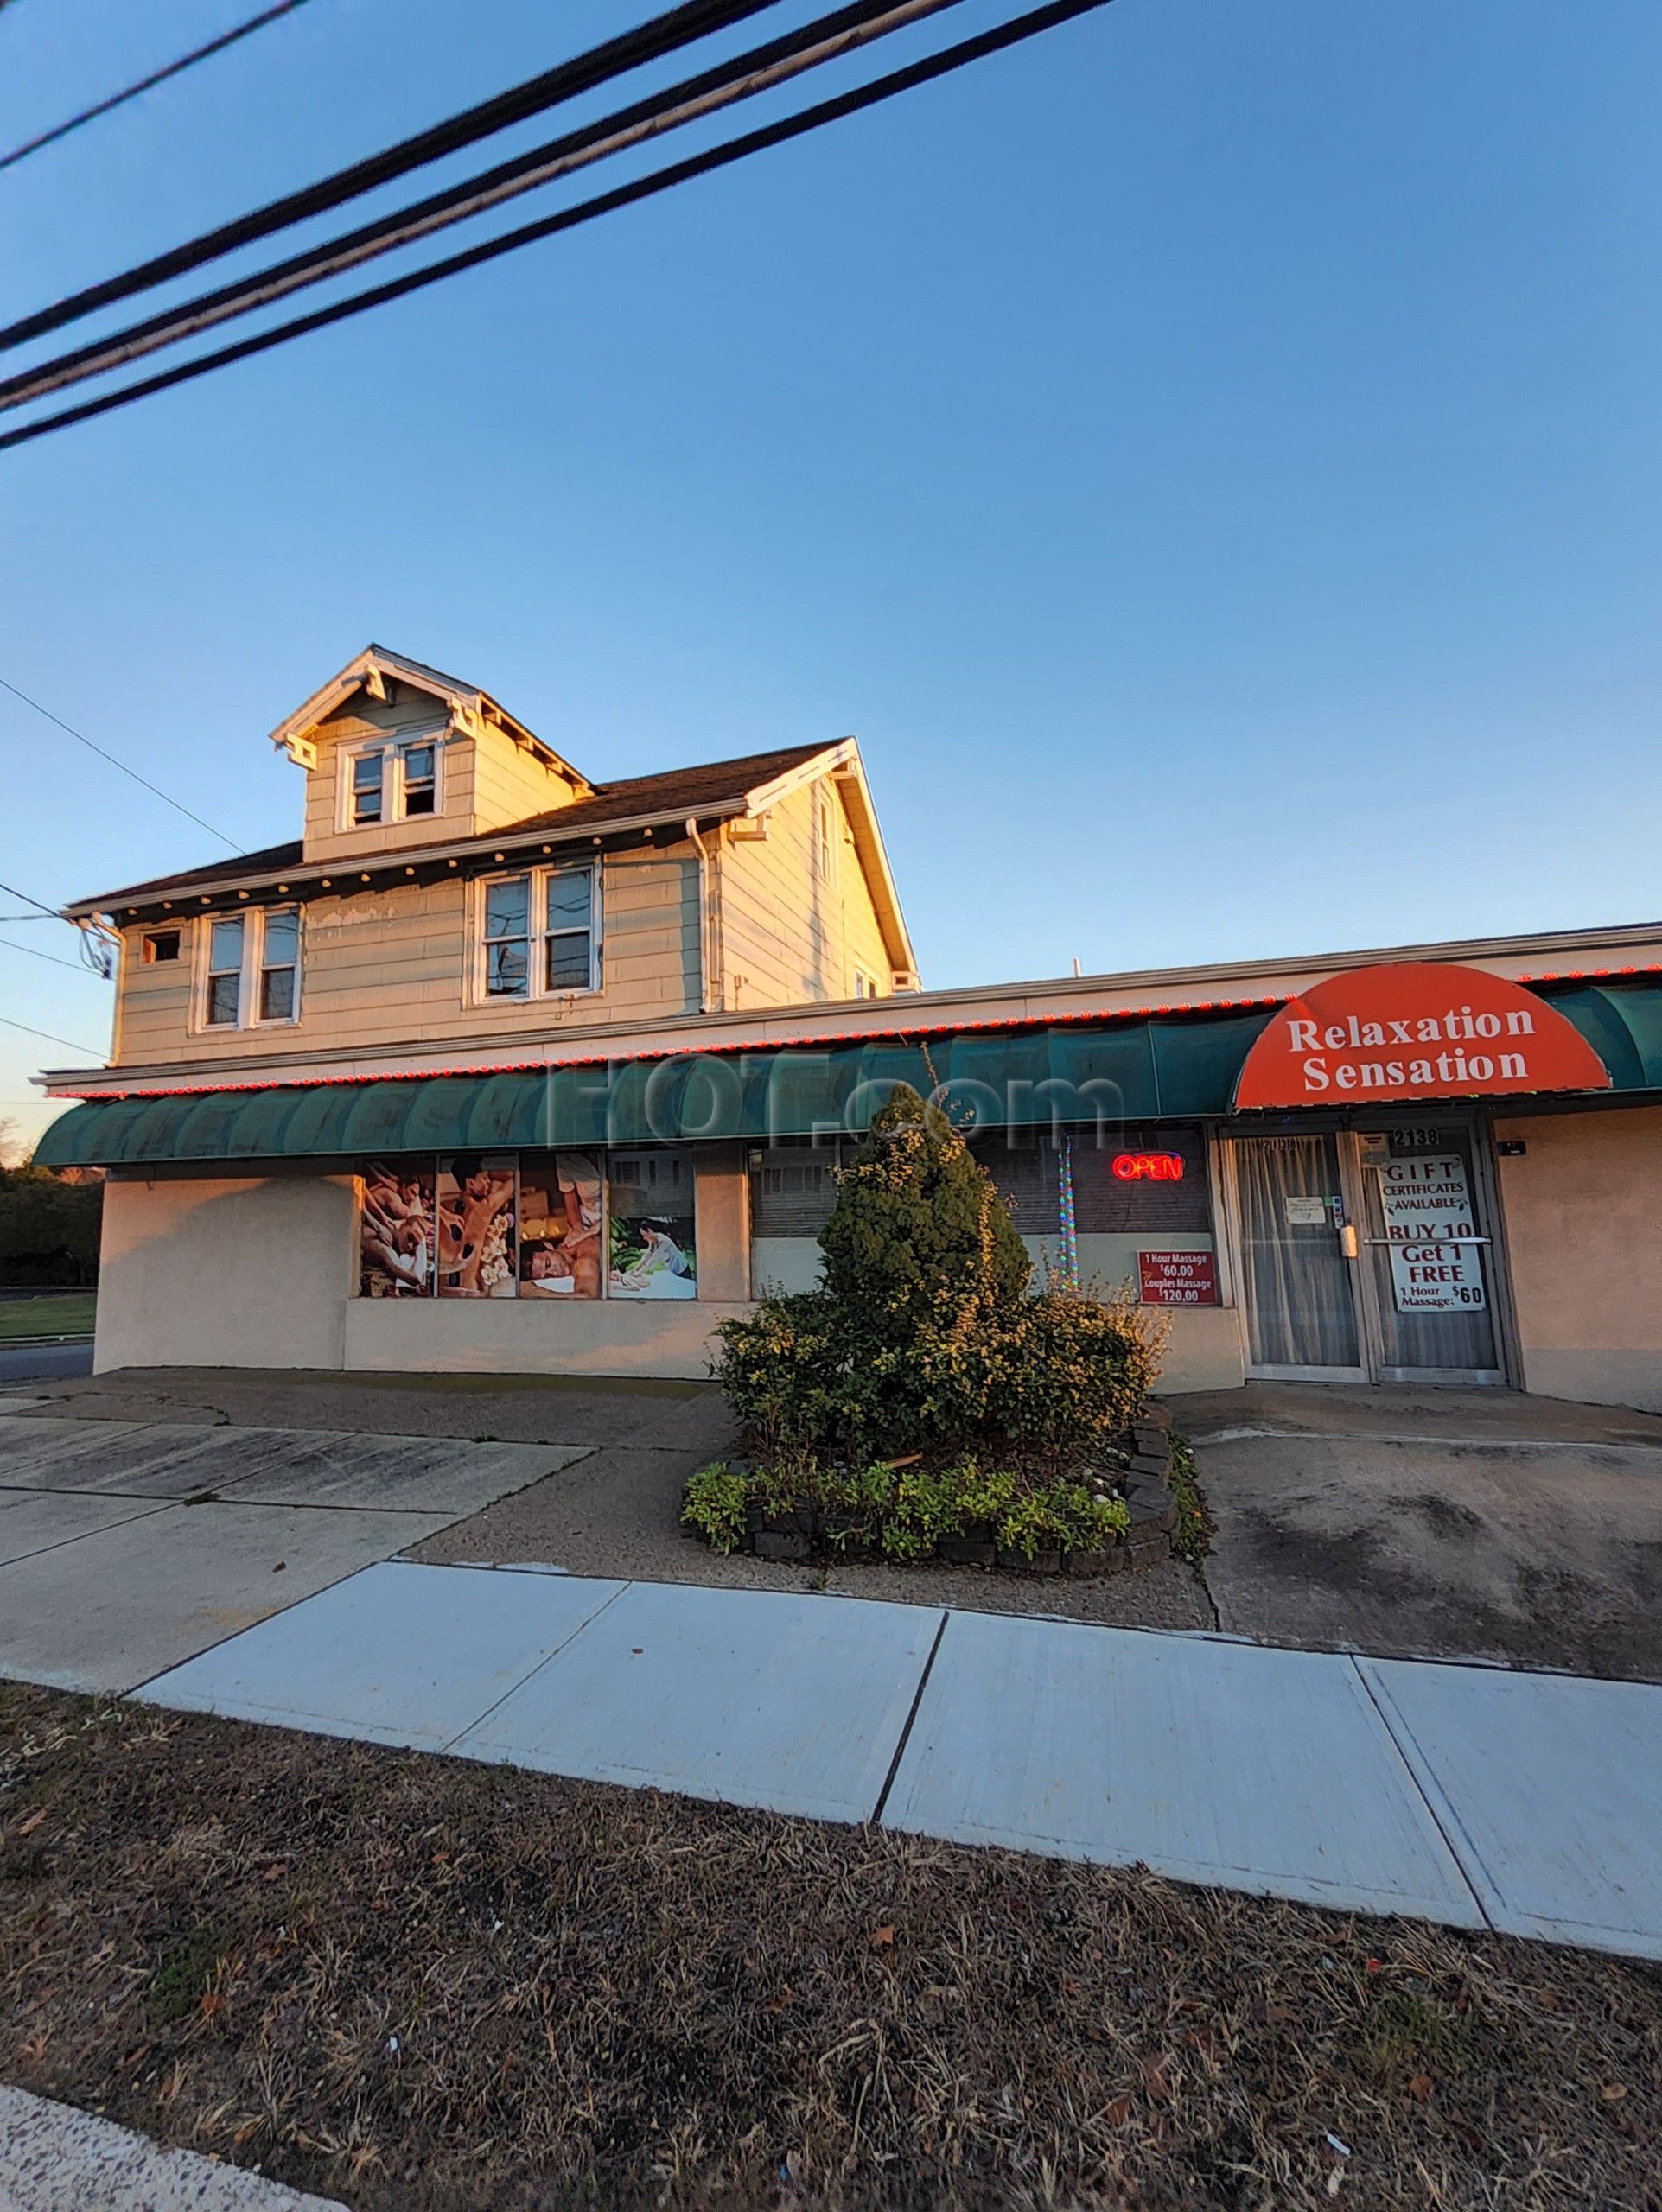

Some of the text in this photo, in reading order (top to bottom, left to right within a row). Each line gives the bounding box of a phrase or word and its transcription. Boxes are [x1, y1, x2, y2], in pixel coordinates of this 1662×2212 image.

[1286, 1005, 1536, 1052] Relaxation
[1302, 1047, 1529, 1091] Sensation
[1395, 1128, 1437, 1146] 2138
[1112, 1154, 1185, 1181] OPEN
[1386, 1162, 1453, 1180] GIFT
[1383, 1182, 1464, 1196] CERTIFICATES
[1395, 1197, 1457, 1211] AVAILABLE
[1388, 1222, 1472, 1240] BUY 10
[1146, 1255, 1207, 1266] 1 Hour Massage
[1401, 1243, 1461, 1262] Get 1
[1160, 1264, 1194, 1277] $60.00
[1409, 1264, 1465, 1283] FREE
[1176, 1279, 1212, 1291] Massage
[1159, 1289, 1199, 1302] $120.00
[1400, 1285, 1482, 1304] 1 Hour $60
[1401, 1296, 1455, 1309] Massage:
